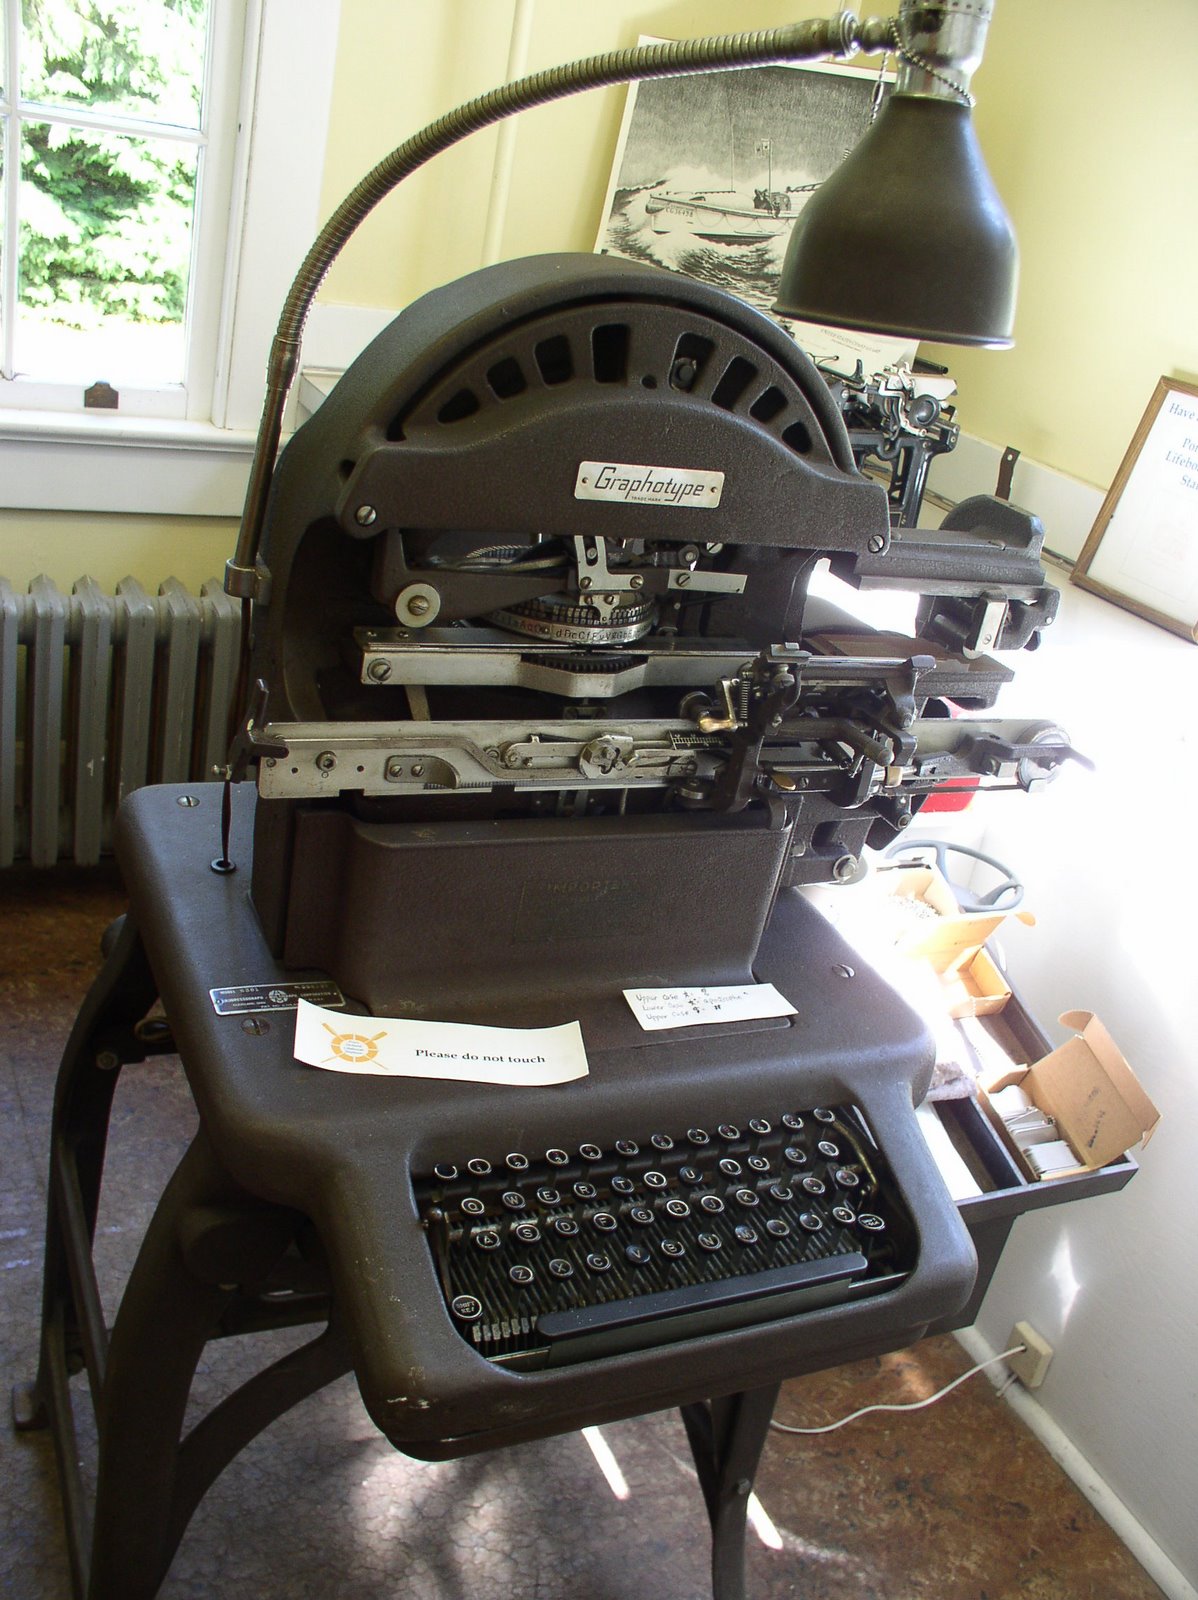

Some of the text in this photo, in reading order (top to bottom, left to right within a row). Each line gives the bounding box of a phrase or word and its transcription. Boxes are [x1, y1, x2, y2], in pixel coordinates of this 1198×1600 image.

[1169, 403, 1195, 420] Have
[594, 466, 705, 503] Graphotype
[415, 1049, 546, 1063] Please do not touch
